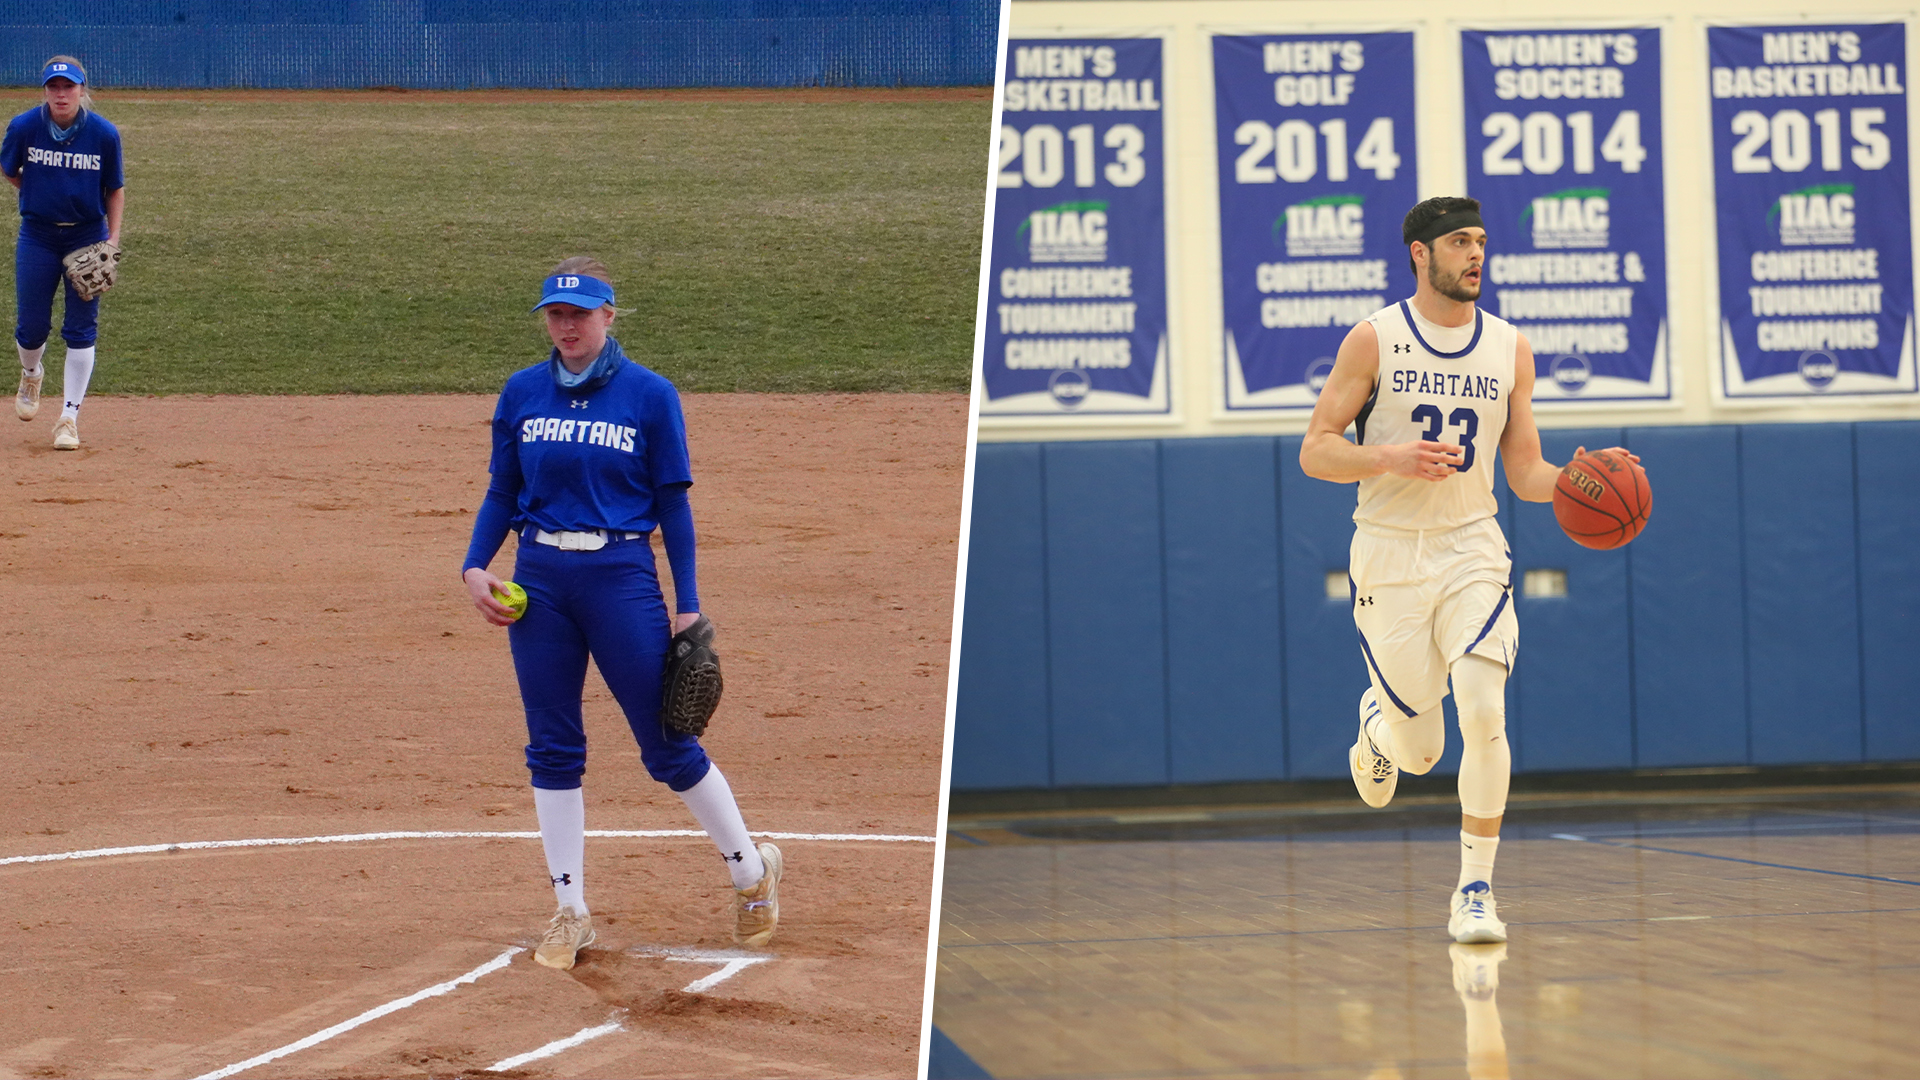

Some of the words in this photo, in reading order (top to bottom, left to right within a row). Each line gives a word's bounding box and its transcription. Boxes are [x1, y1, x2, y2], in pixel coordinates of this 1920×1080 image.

[1015, 46, 1116, 78] MEN'S
[1264, 40, 1364, 73] MEN'S
[1485, 33, 1638, 67] WOMEN'S
[1763, 31, 1860, 64] MEN'S
[1002, 79, 1160, 112] SKETBALL
[1274, 74, 1355, 107] GOLF
[1495, 67, 1624, 100] SOCCER
[1712, 64, 1904, 99] BASKETBALL
[997, 124, 1145, 188] 2013
[1234, 117, 1400, 184] 2014
[1482, 110, 1646, 176] 2014
[1731, 107, 1890, 174] 2015
[27, 147, 101, 171] SPARTANS
[1256, 259, 1388, 293] CONFERENCE
[1490, 252, 1620, 285] CONFERENCE
[1624, 252, 1646, 282] &
[1751, 249, 1879, 282] CONFERENCE
[556, 277, 580, 288] UD
[1001, 267, 1132, 298] CONFERENCE
[1496, 287, 1634, 320] TOURNAMENT
[1749, 284, 1883, 317] TOURNAMENT
[998, 302, 1137, 334] TOURNAMENT
[1517, 323, 1629, 355] HAMPIONS
[1757, 320, 1878, 352] CHAMPIONS
[1005, 338, 1132, 370] CHAMPIONS
[1392, 370, 1499, 401] SPARTANS
[522, 417, 637, 453] SPARTANS
[1411, 404, 1479, 473] 33
